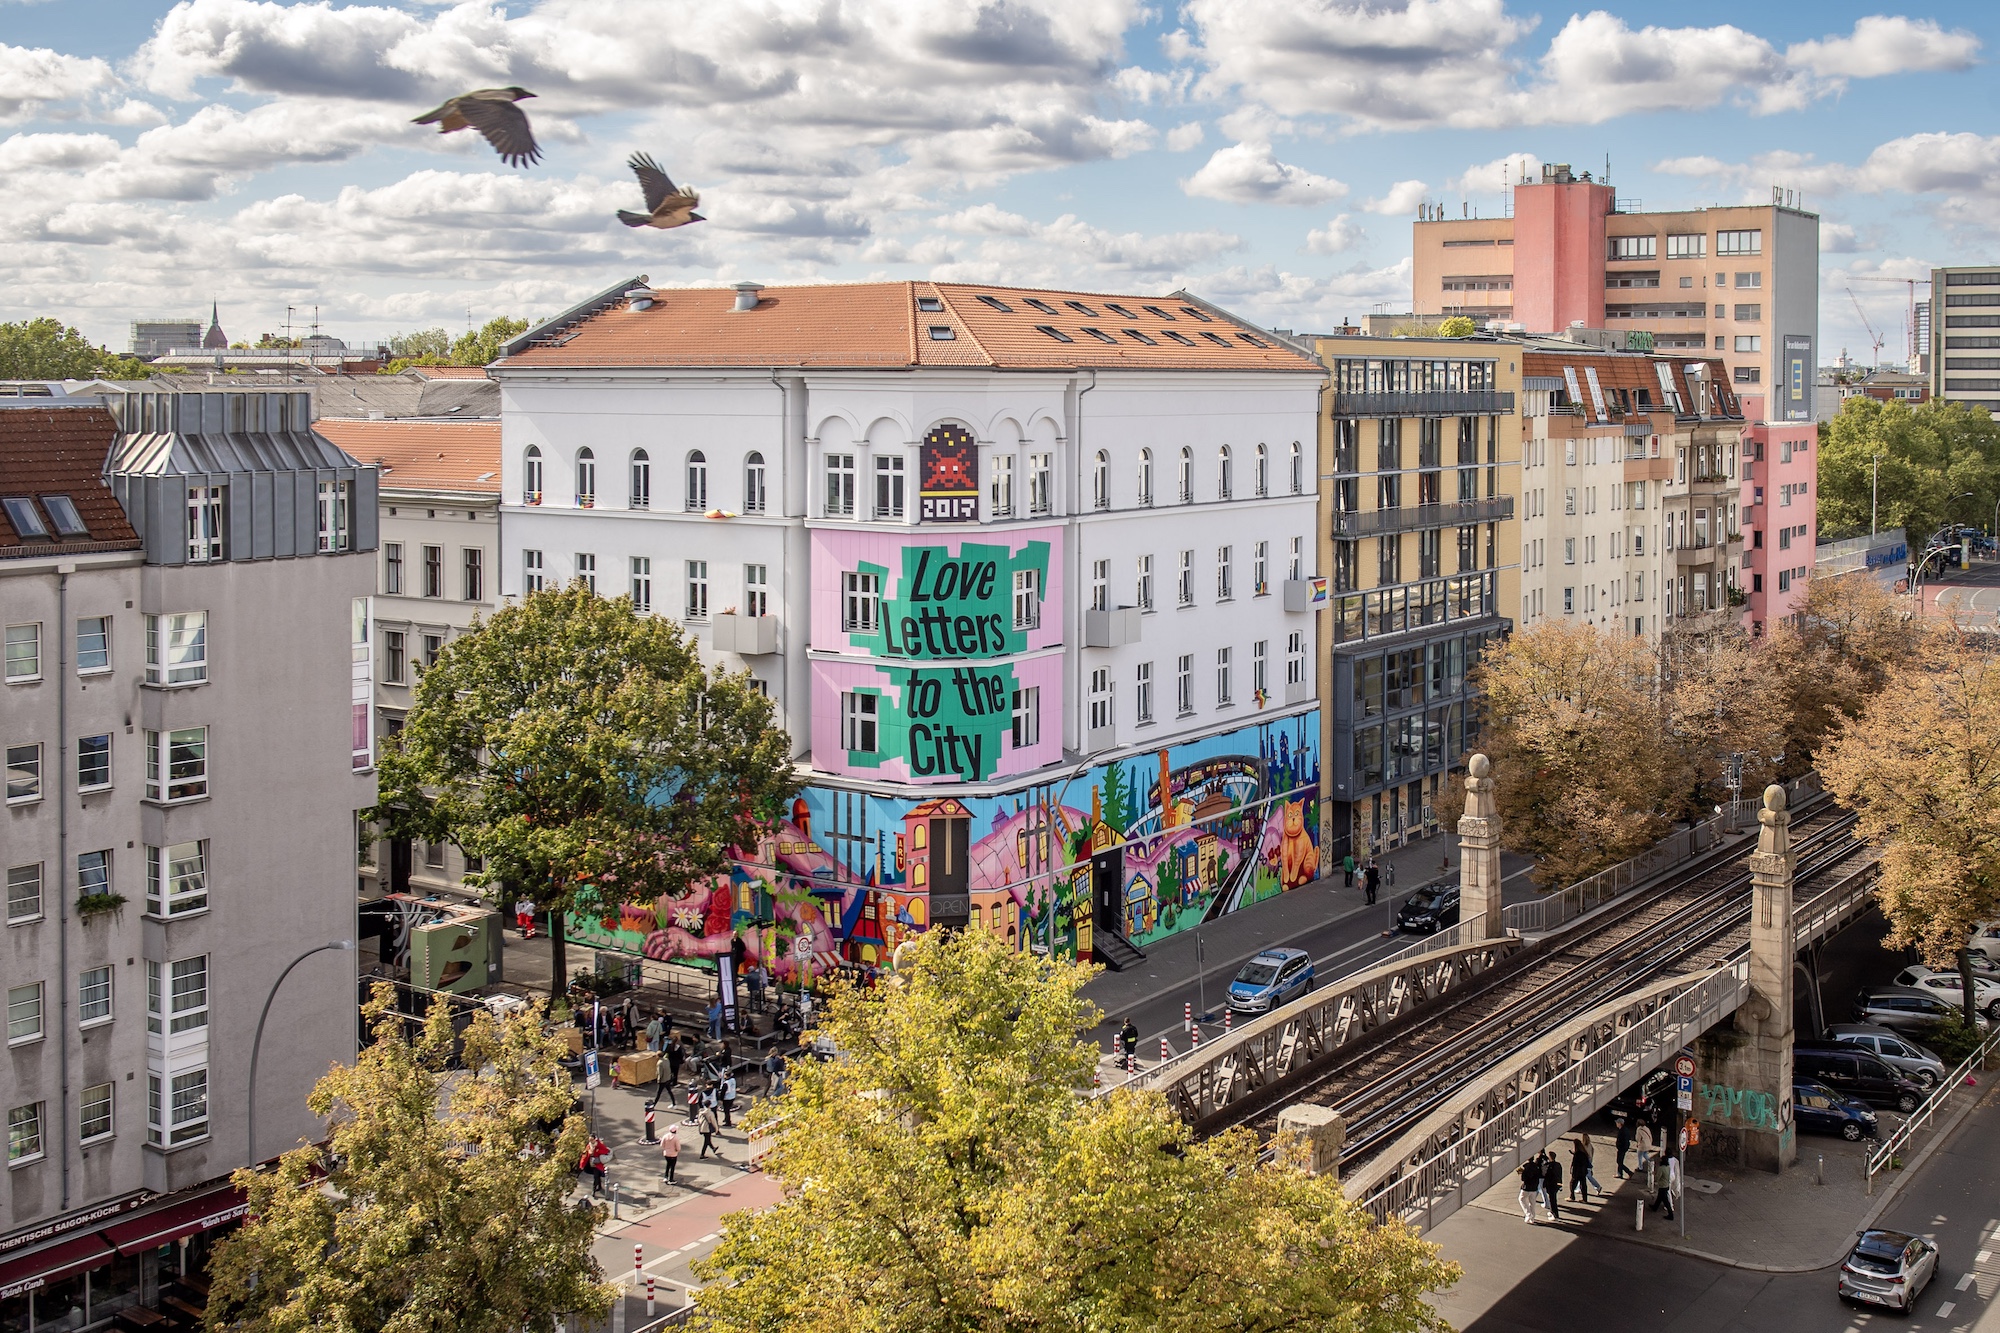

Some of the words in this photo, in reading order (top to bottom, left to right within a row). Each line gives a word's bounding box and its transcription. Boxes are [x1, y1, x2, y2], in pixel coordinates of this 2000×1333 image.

[923, 499, 975, 517] 2017
[909, 550, 997, 602] Love
[881, 602, 1005, 656] Letters
[907, 669, 942, 718] to
[952, 667, 1006, 717] the
[908, 723, 982, 782] City
[930, 899, 968, 914] OPEN
[1681, 1078, 1689, 1089] P
[54, 1204, 121, 1232] SAIGON-KÜCHE
[24, 1278, 45, 1291] Canh
